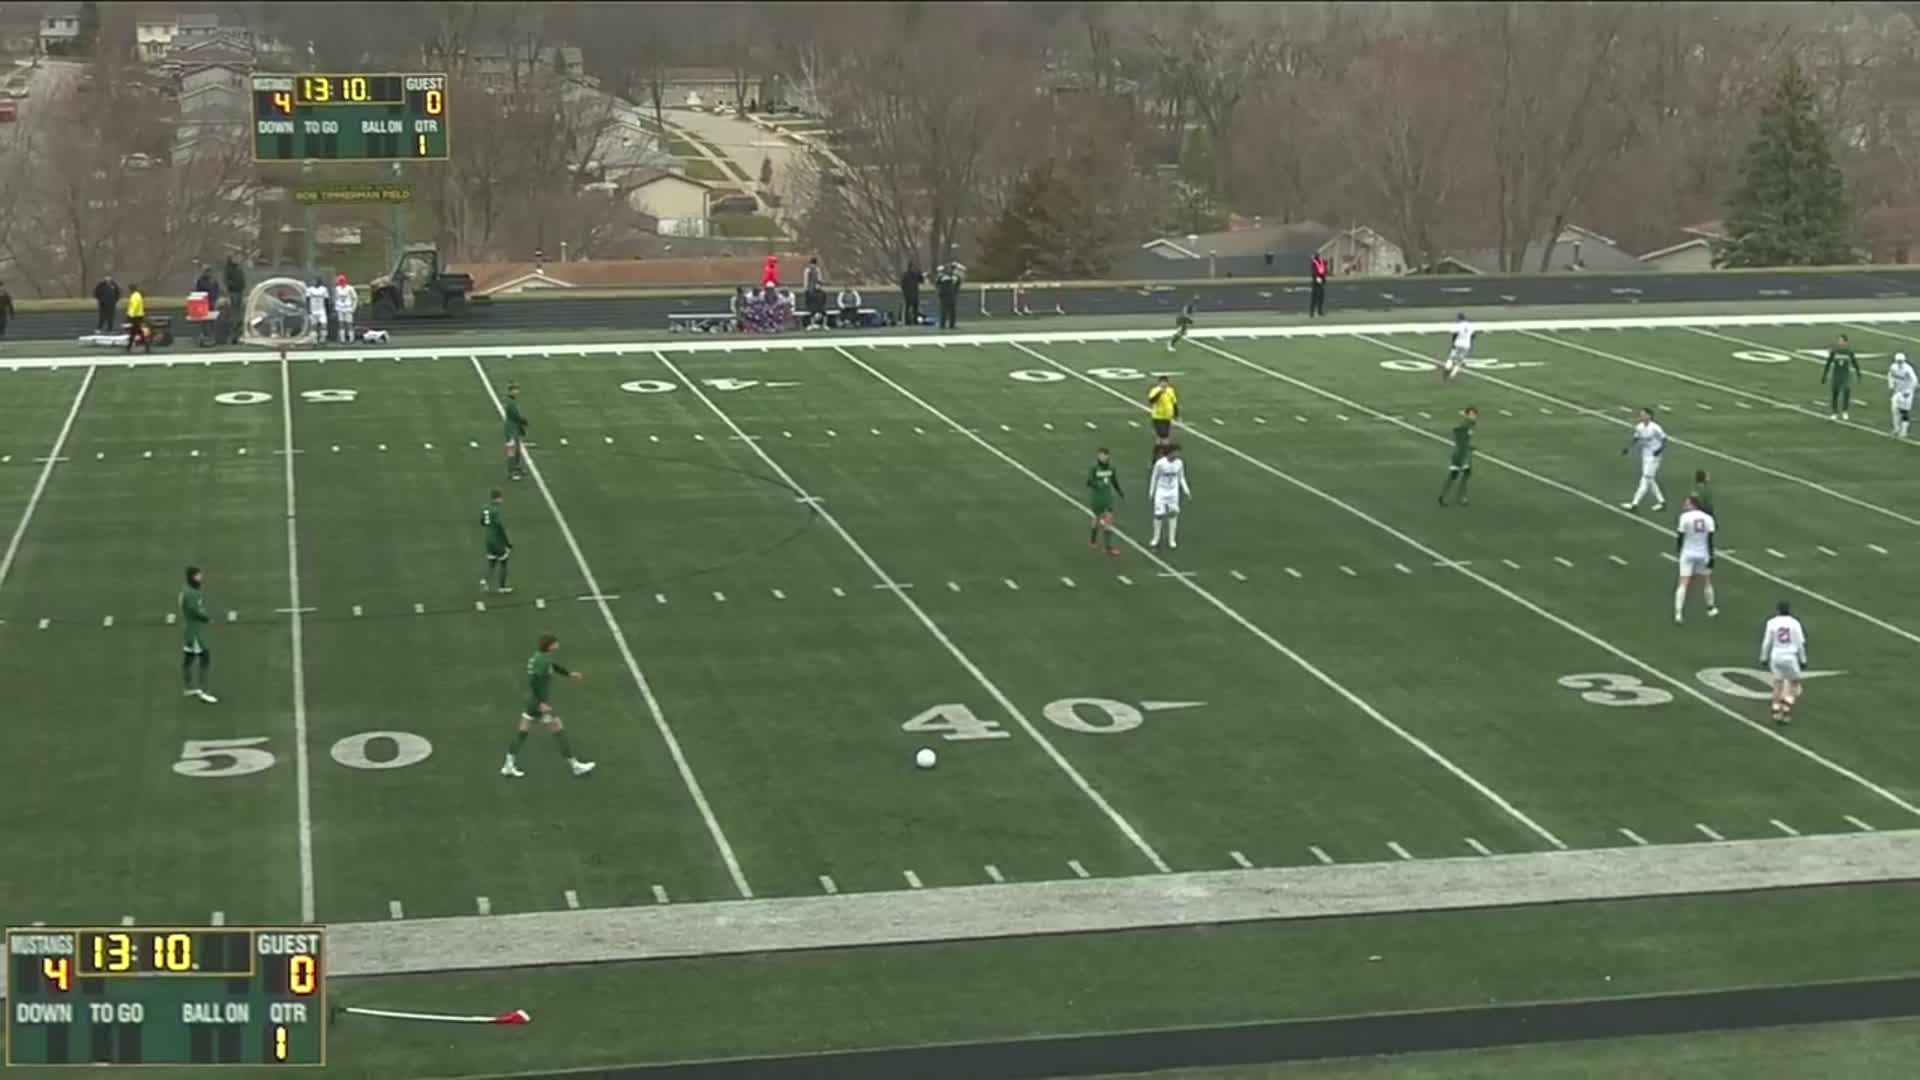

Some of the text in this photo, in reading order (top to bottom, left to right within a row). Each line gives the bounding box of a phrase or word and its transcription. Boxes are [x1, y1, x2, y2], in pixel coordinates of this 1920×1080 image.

[406, 78, 443, 90] GUEST
[274, 92, 290, 113] 4
[426, 91, 442, 114] 0
[258, 121, 294, 133] DOWN
[304, 121, 339, 133] TO GO
[361, 120, 403, 133] BALL ON
[415, 120, 437, 132] QTR
[419, 135, 427, 155] 1
